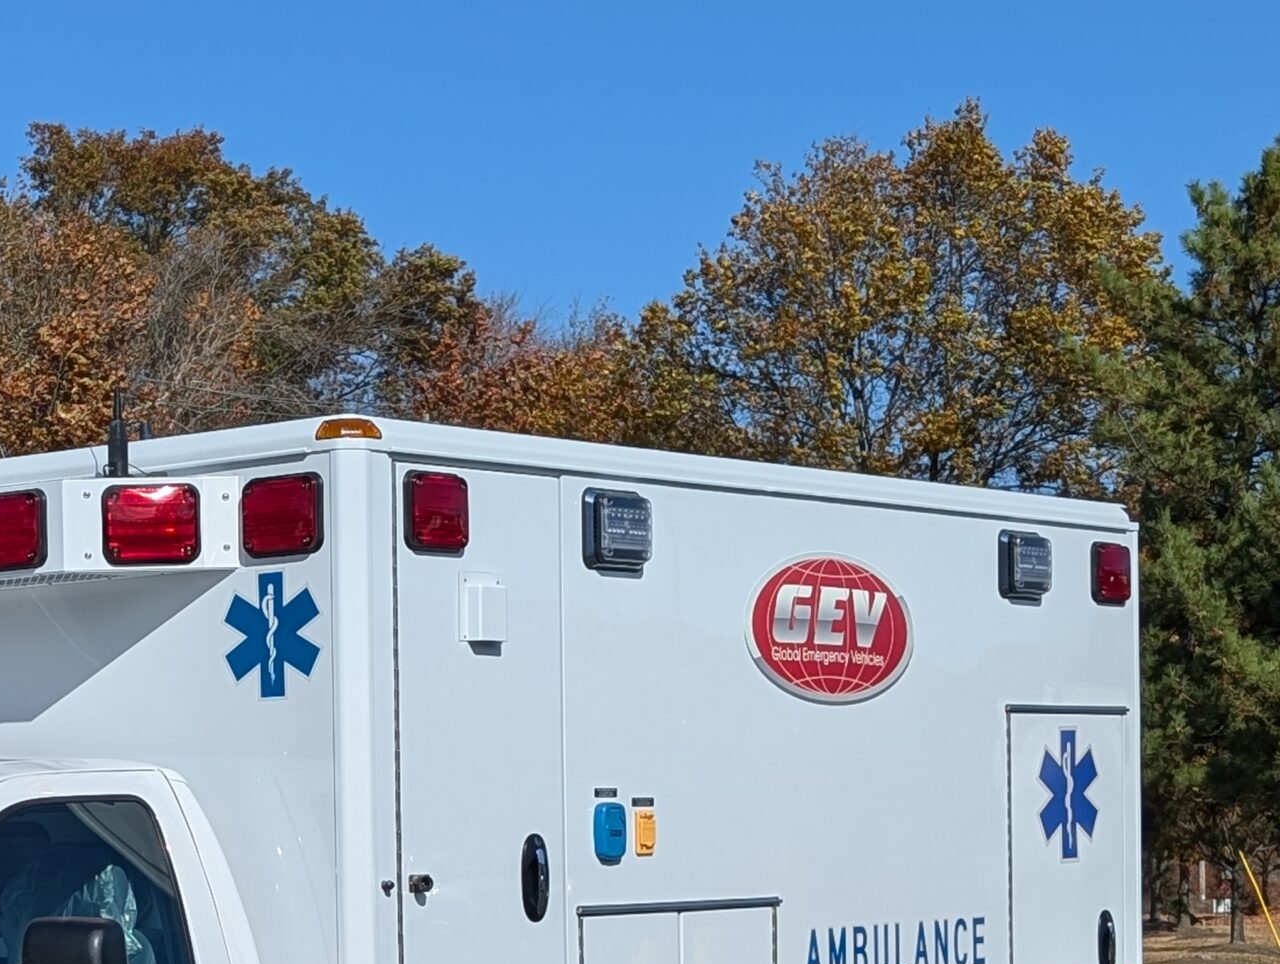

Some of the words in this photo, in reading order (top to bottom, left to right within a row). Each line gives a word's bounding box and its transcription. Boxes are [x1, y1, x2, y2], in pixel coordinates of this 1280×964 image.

[772, 583, 888, 649] GEV
[771, 645, 801, 661] Global
[802, 647, 849, 666] Emergency
[851, 649, 885, 667] Vehicles
